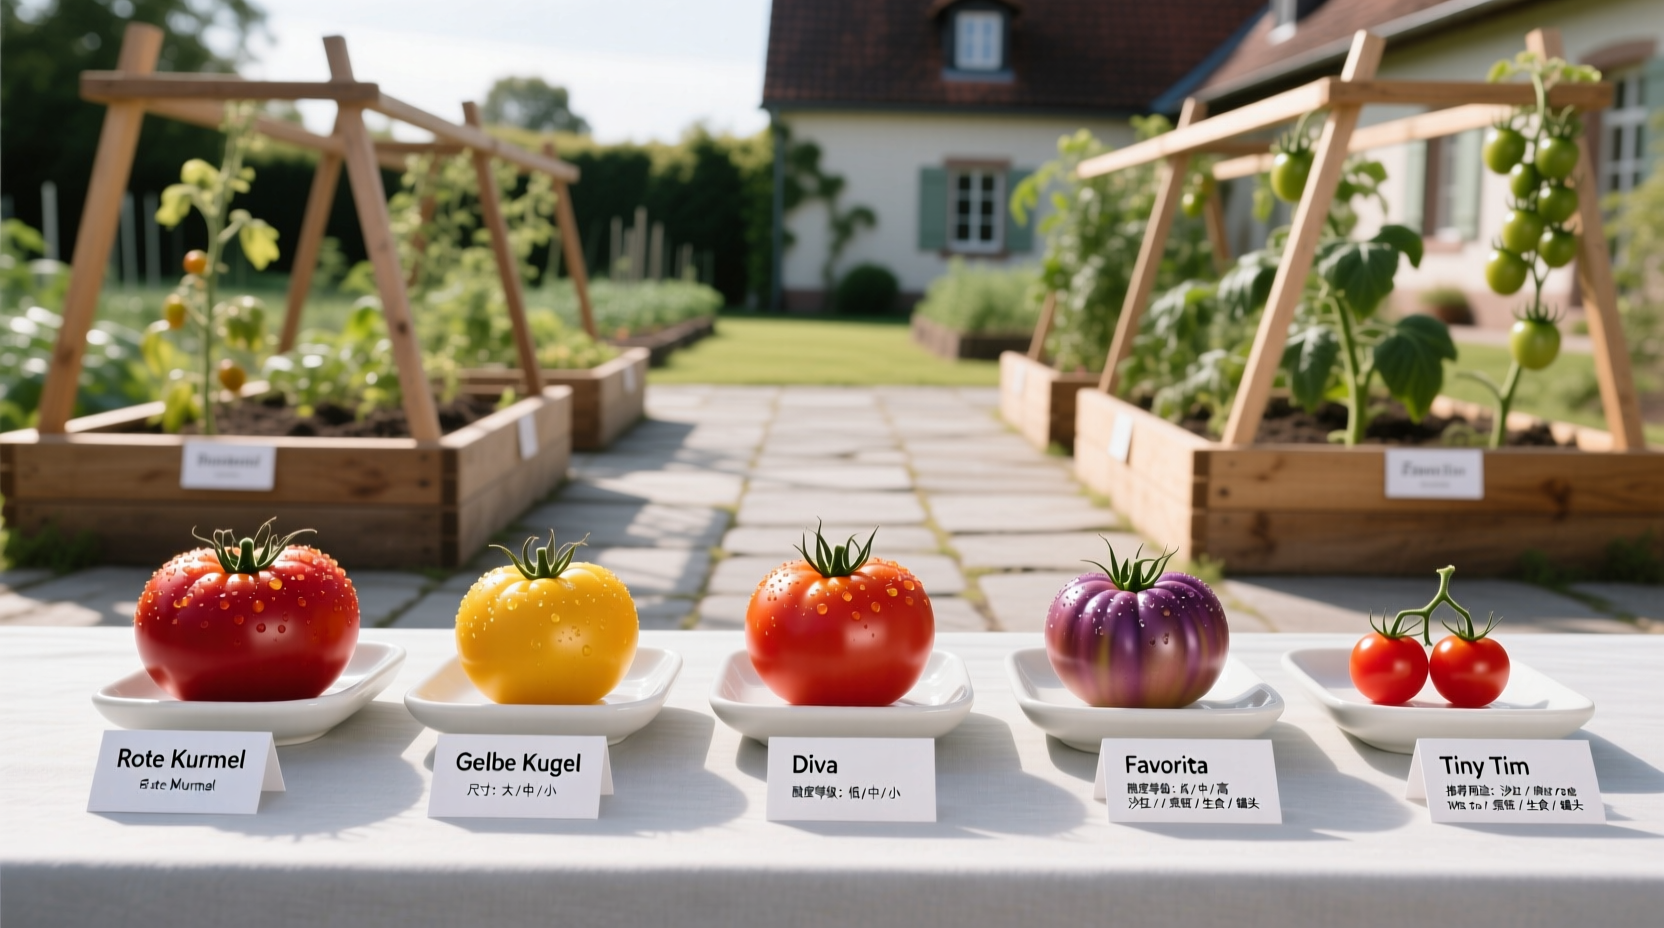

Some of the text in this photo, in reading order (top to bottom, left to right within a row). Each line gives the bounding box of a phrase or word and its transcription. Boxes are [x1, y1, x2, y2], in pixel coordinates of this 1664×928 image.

[117, 748, 246, 769] Rote Kurmel
[456, 751, 581, 777] Gelbe Kugel
[792, 754, 838, 774] Diva
[1125, 755, 1209, 774] Favorita
[1439, 755, 1530, 779] Tiny Tim
